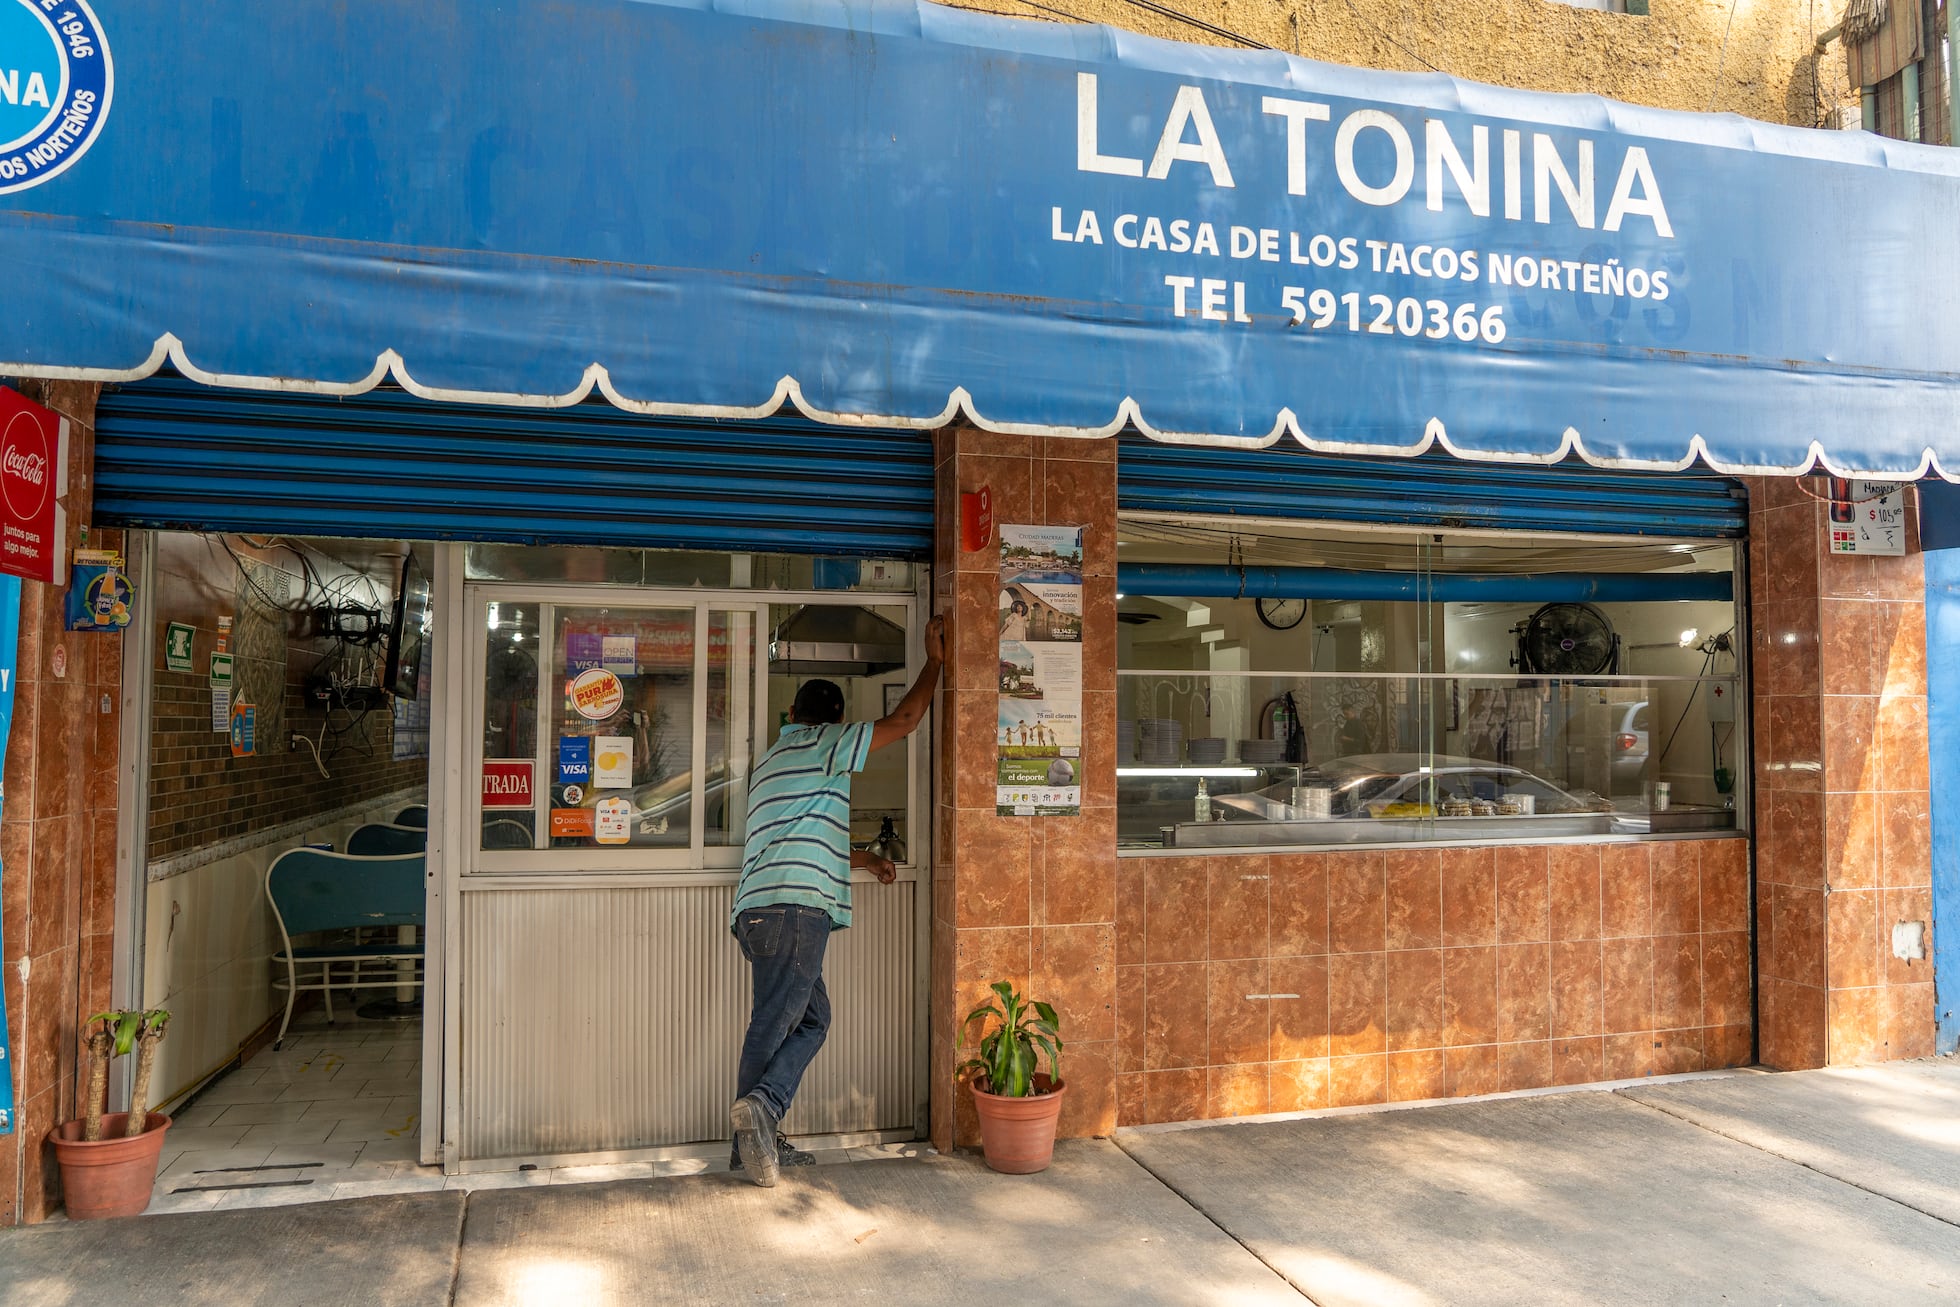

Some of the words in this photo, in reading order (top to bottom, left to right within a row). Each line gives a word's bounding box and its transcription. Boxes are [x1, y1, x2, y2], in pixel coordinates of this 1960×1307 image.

[57, 10, 95, 59] 1946
[25, 88, 97, 170] NORTEÑOS
[1077, 72, 1236, 189] LA
[1262, 96, 1676, 240] TONINA
[1052, 206, 1103, 245] LA
[1113, 213, 1221, 257] CASA
[1231, 226, 1281, 263] DE
[1290, 231, 1360, 271] LOS
[1366, 240, 1481, 283] TACOS
[1488, 252, 1670, 301] NORTEÑOS
[1165, 275, 1253, 323] TEL
[1281, 286, 1507, 345] 59120366
[4, 522, 25, 539] juntos
[25, 531, 40, 543] para
[4, 539, 20, 554] algo
[20, 545, 39, 558] mejor.
[1043, 591, 1077, 599] innovación
[604, 647, 634, 657] OPEN
[574, 660, 599, 670] VISA
[561, 764, 588, 775] VISA
[1008, 773, 1015, 781] el
[1016, 773, 1045, 782] deporte
[482, 774, 529, 794] TRADA
